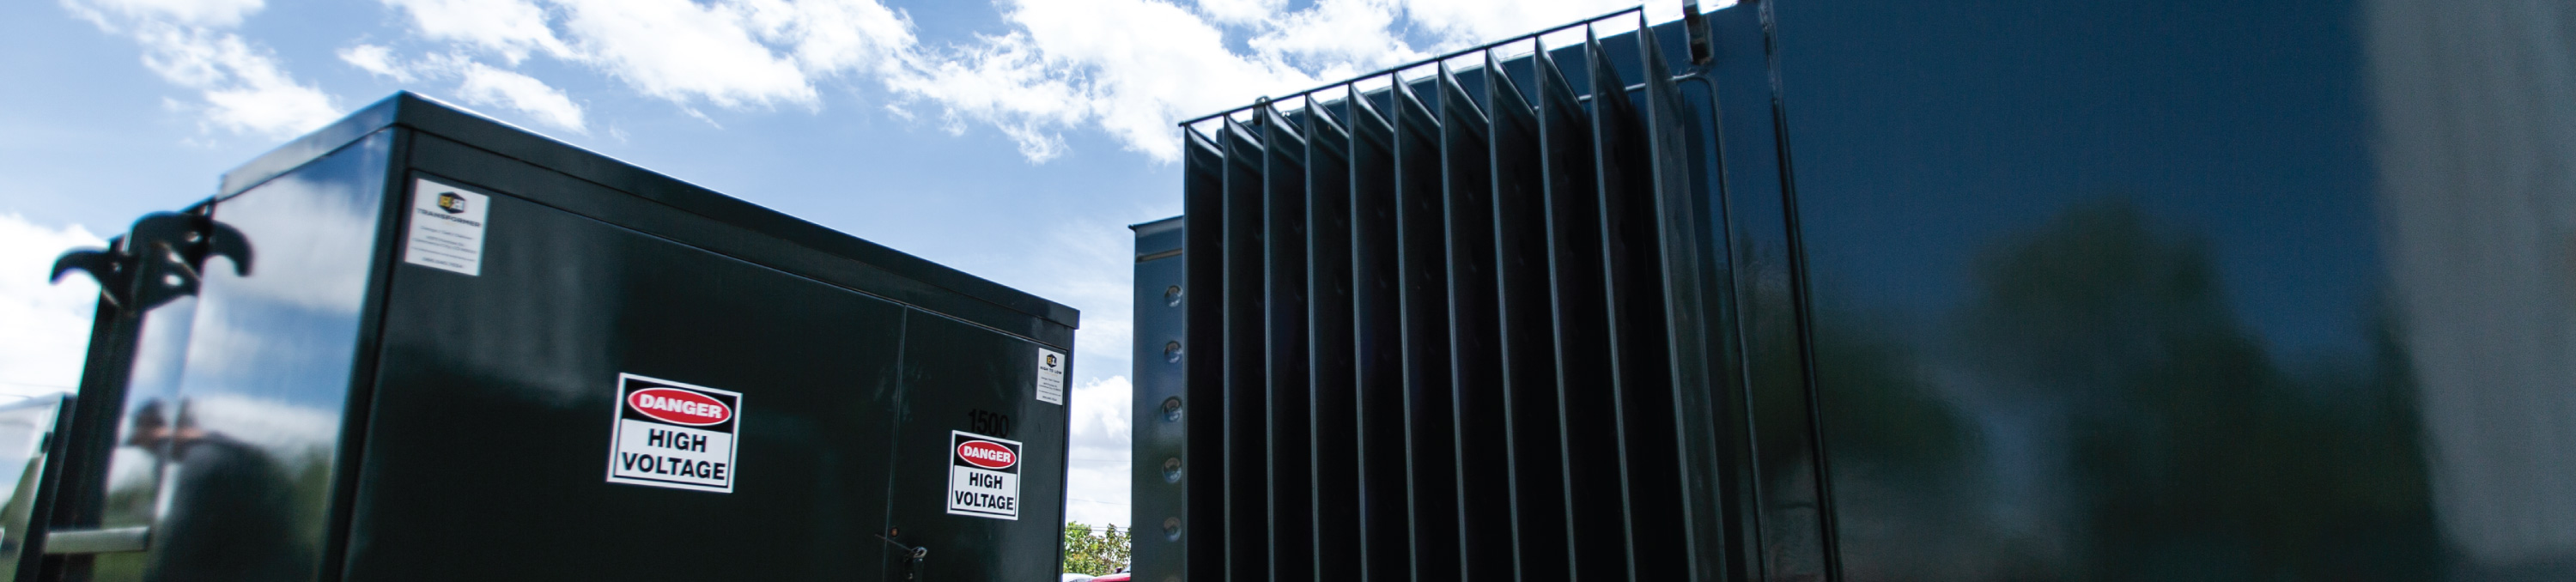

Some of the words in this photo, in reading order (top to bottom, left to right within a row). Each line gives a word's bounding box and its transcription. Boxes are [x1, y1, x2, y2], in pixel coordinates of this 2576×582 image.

[416, 208, 481, 227] TRANSFORMER
[640, 394, 722, 418] DANGER
[969, 409, 1009, 439] 1500
[647, 428, 707, 452] HIGH
[963, 446, 1011, 463] DANGER
[622, 452, 726, 480] VOLTAGE
[969, 471, 1003, 489] HIGH
[955, 490, 1013, 510] VOLTAGE
